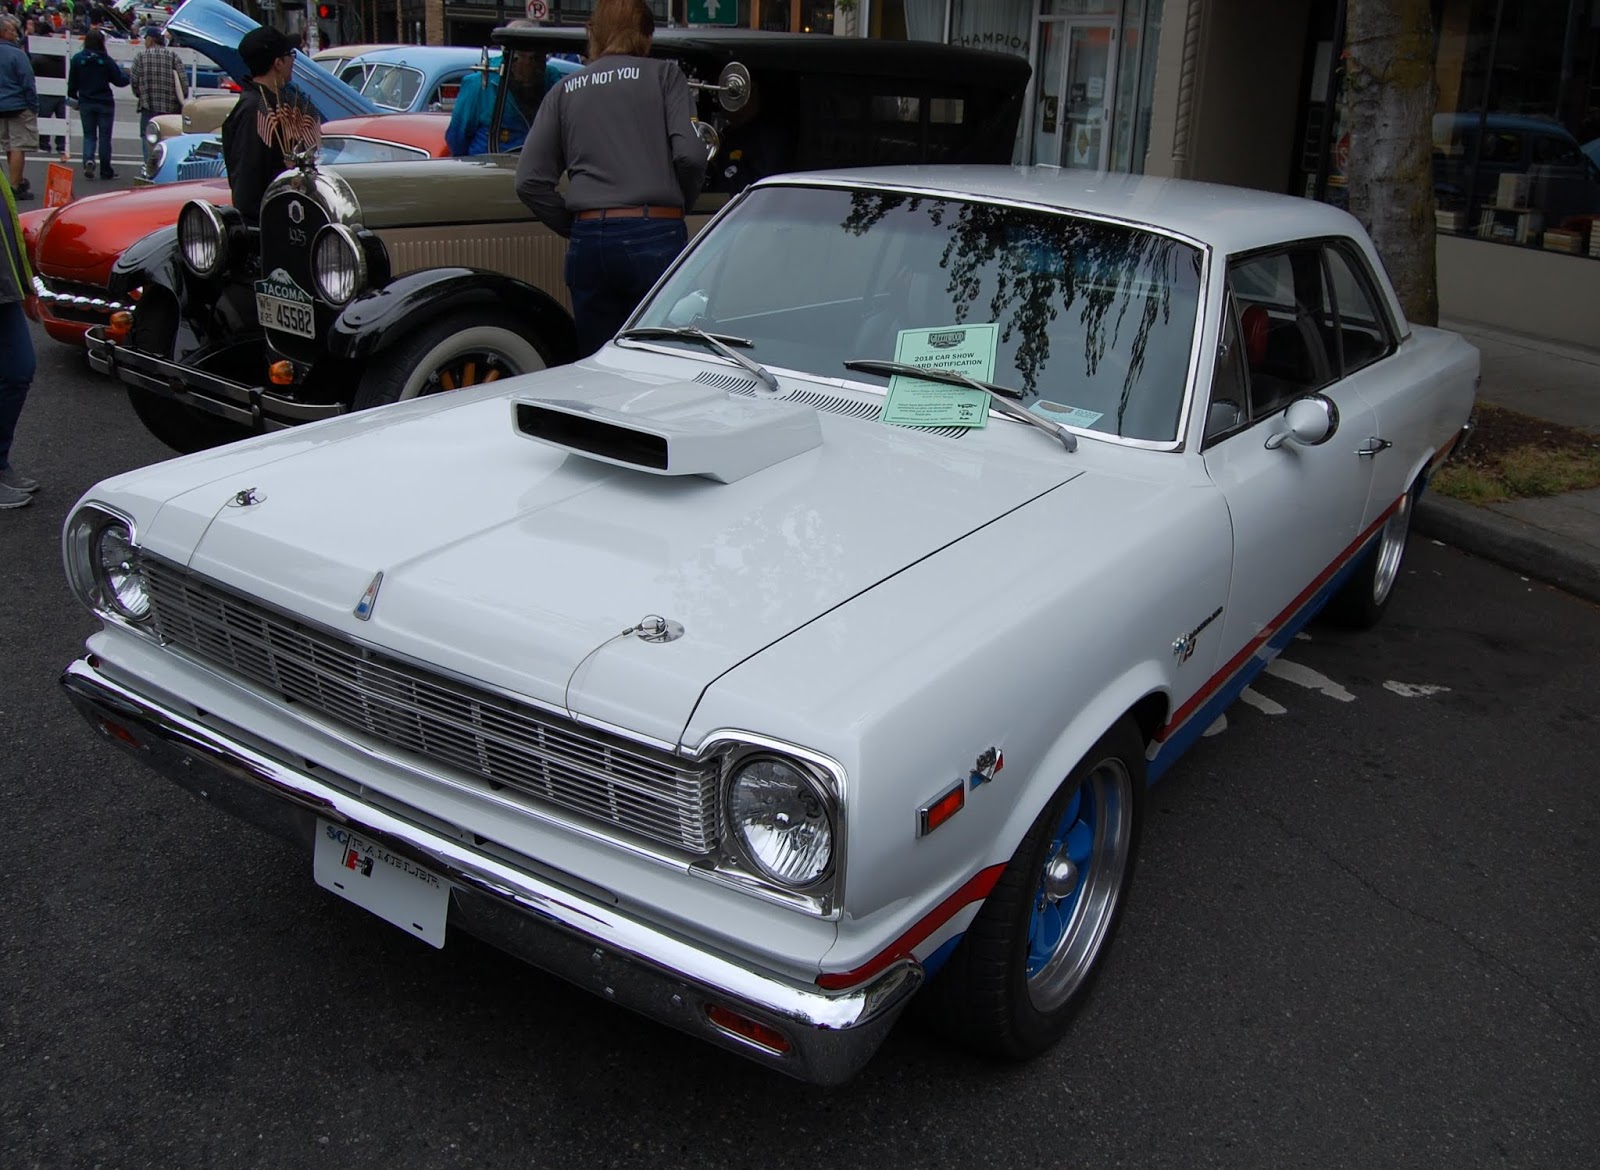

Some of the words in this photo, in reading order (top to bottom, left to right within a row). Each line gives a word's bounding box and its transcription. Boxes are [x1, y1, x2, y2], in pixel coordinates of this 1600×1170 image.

[564, 74, 589, 94] WHY
[591, 70, 615, 85] NOT
[617, 67, 640, 80] YOU
[261, 282, 305, 303] TACOMA
[276, 303, 312, 334] 45582
[933, 359, 983, 368] NOTIFICATION
